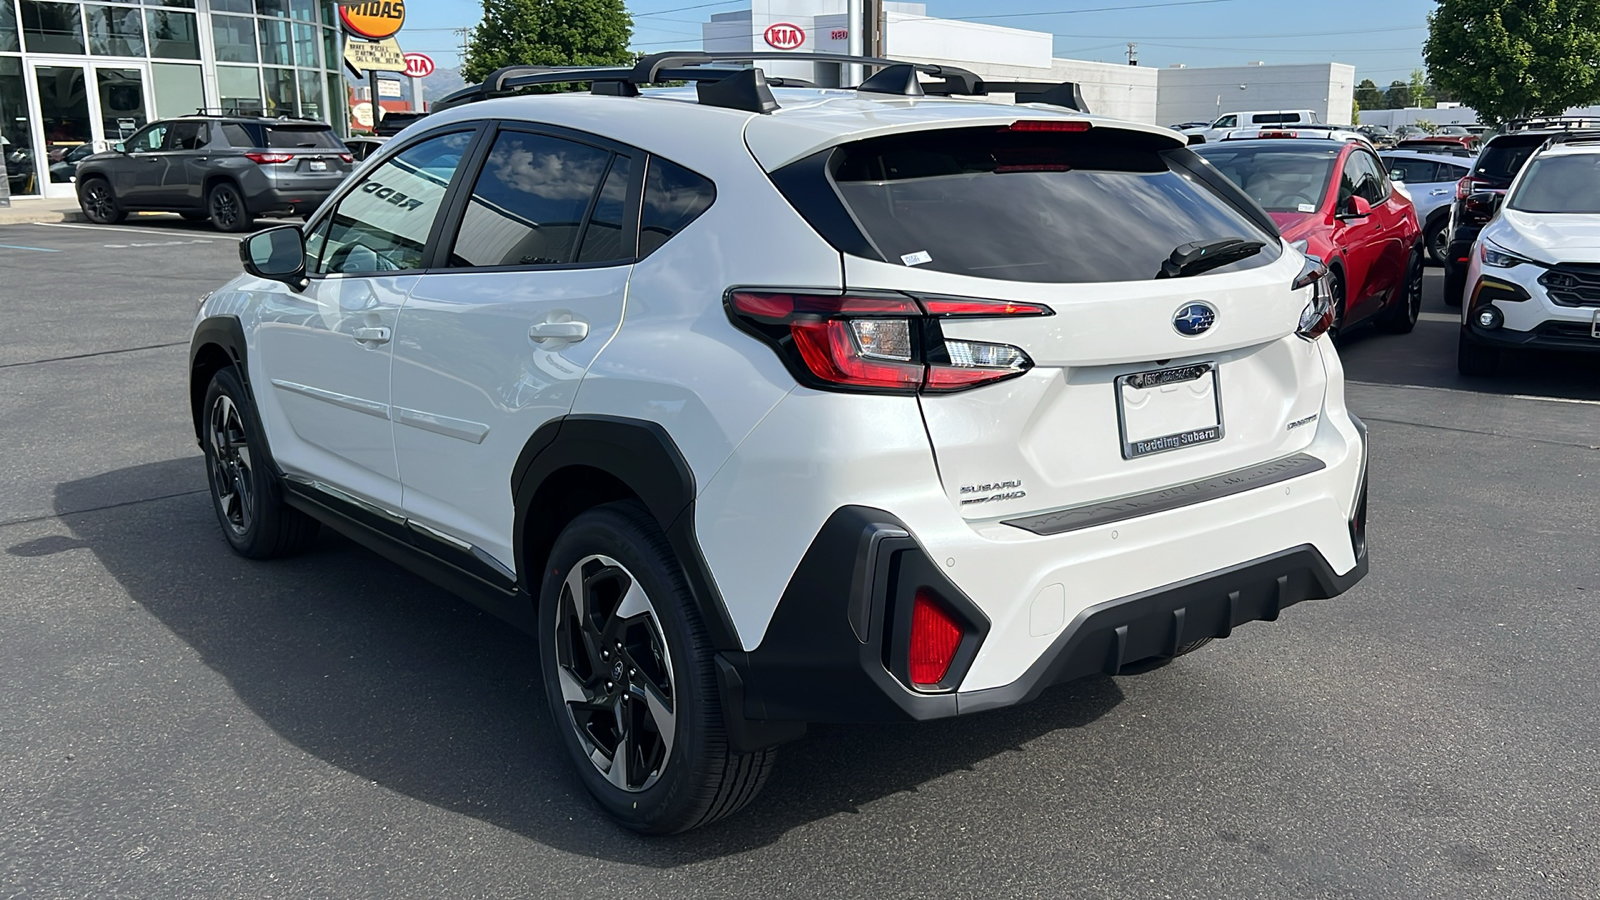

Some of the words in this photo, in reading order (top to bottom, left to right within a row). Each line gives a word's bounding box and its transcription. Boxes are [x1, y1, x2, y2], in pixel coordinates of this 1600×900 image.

[346, 1, 403, 19] MIDAS
[771, 29, 799, 44] KIA
[406, 59, 429, 73] KIA
[1136, 435, 1180, 454] Redding
[1181, 428, 1215, 444] Subaru
[960, 479, 1022, 494] SUBARU
[985, 490, 1027, 503] AWD
